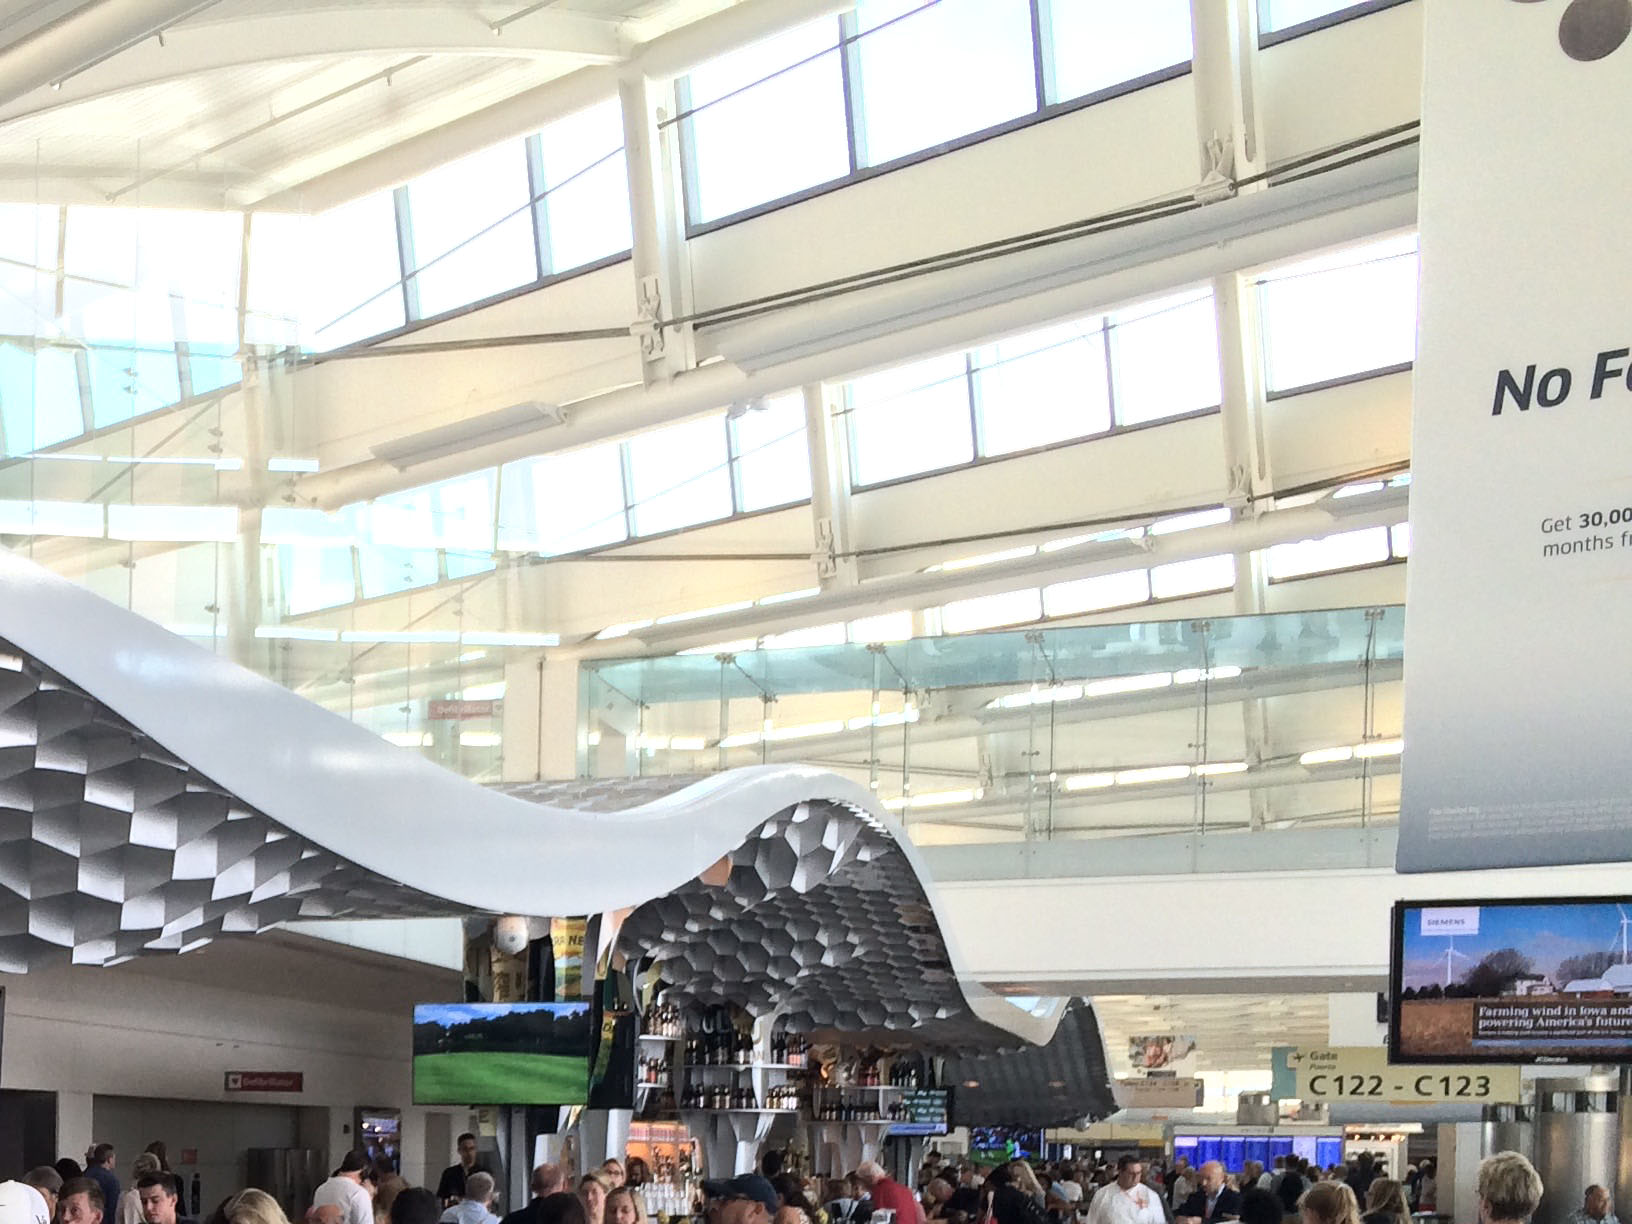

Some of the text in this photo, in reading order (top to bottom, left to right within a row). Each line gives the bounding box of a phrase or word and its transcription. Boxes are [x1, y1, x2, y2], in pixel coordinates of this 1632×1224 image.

[1541, 515, 1572, 534] Get
[1543, 535, 1614, 557] months
[1479, 1004, 1632, 1017] Farming wind in Iowa and
[1479, 1017, 1534, 1029] powering
[1536, 1016, 1593, 1027] America's
[1309, 1051, 1338, 1061] Gate
